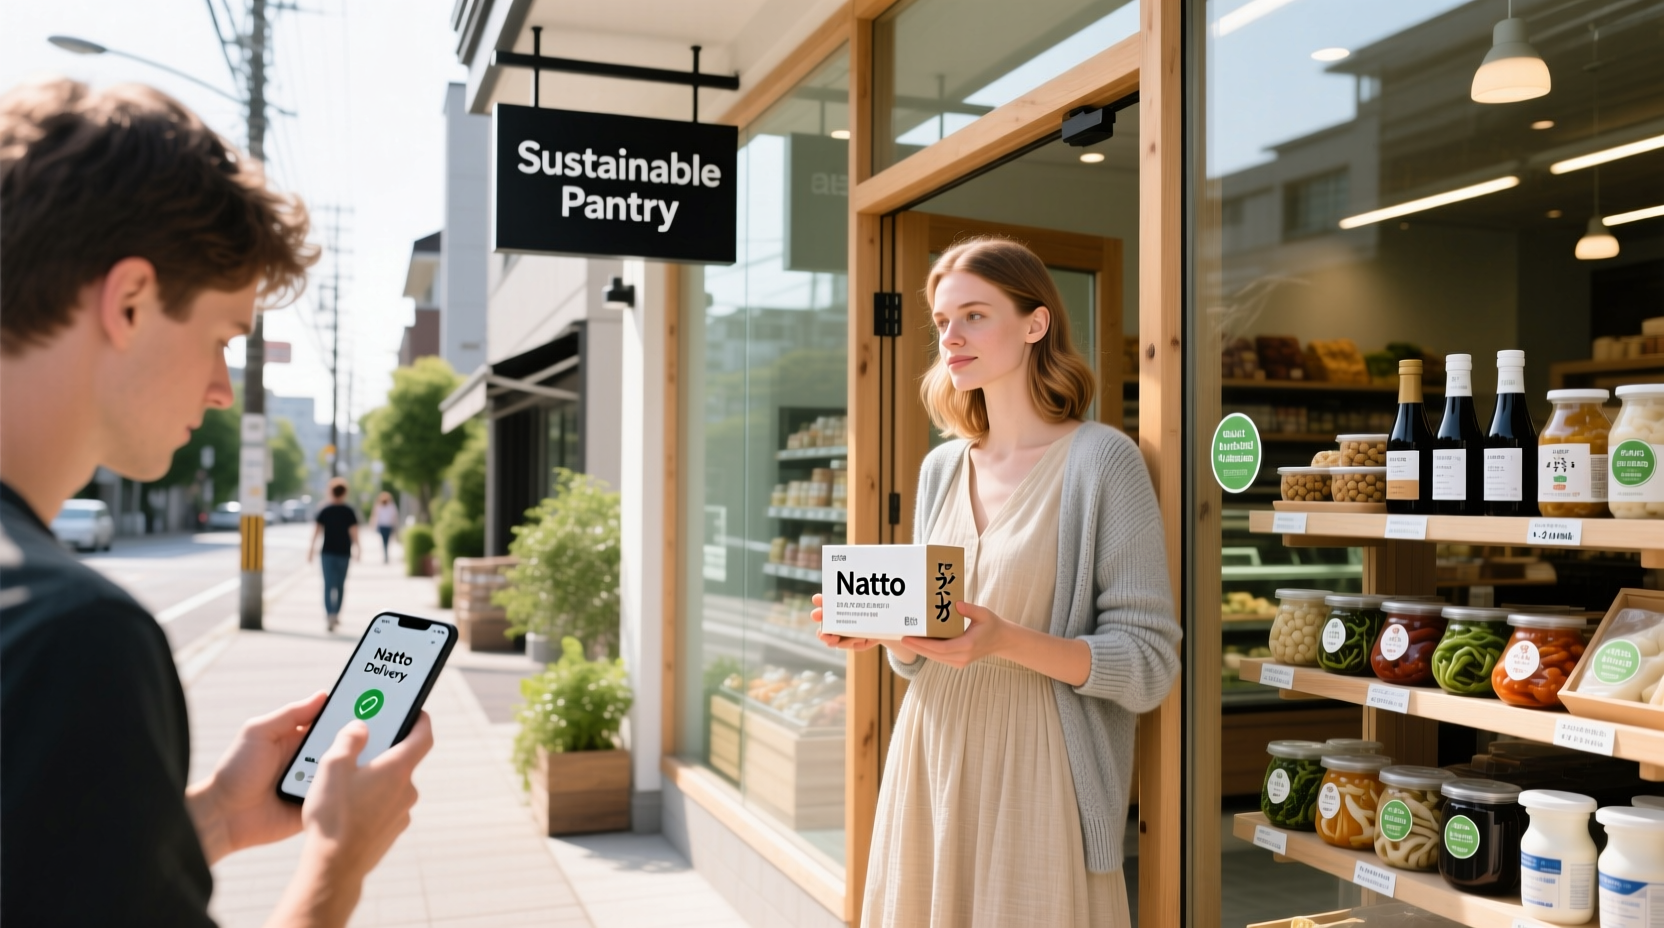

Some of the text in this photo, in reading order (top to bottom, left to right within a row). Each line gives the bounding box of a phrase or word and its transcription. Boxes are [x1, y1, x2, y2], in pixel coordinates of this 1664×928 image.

[517, 139, 721, 188] Sustainable
[561, 185, 679, 233] Pantry
[836, 570, 906, 596] Natto
[373, 647, 413, 666] Natto
